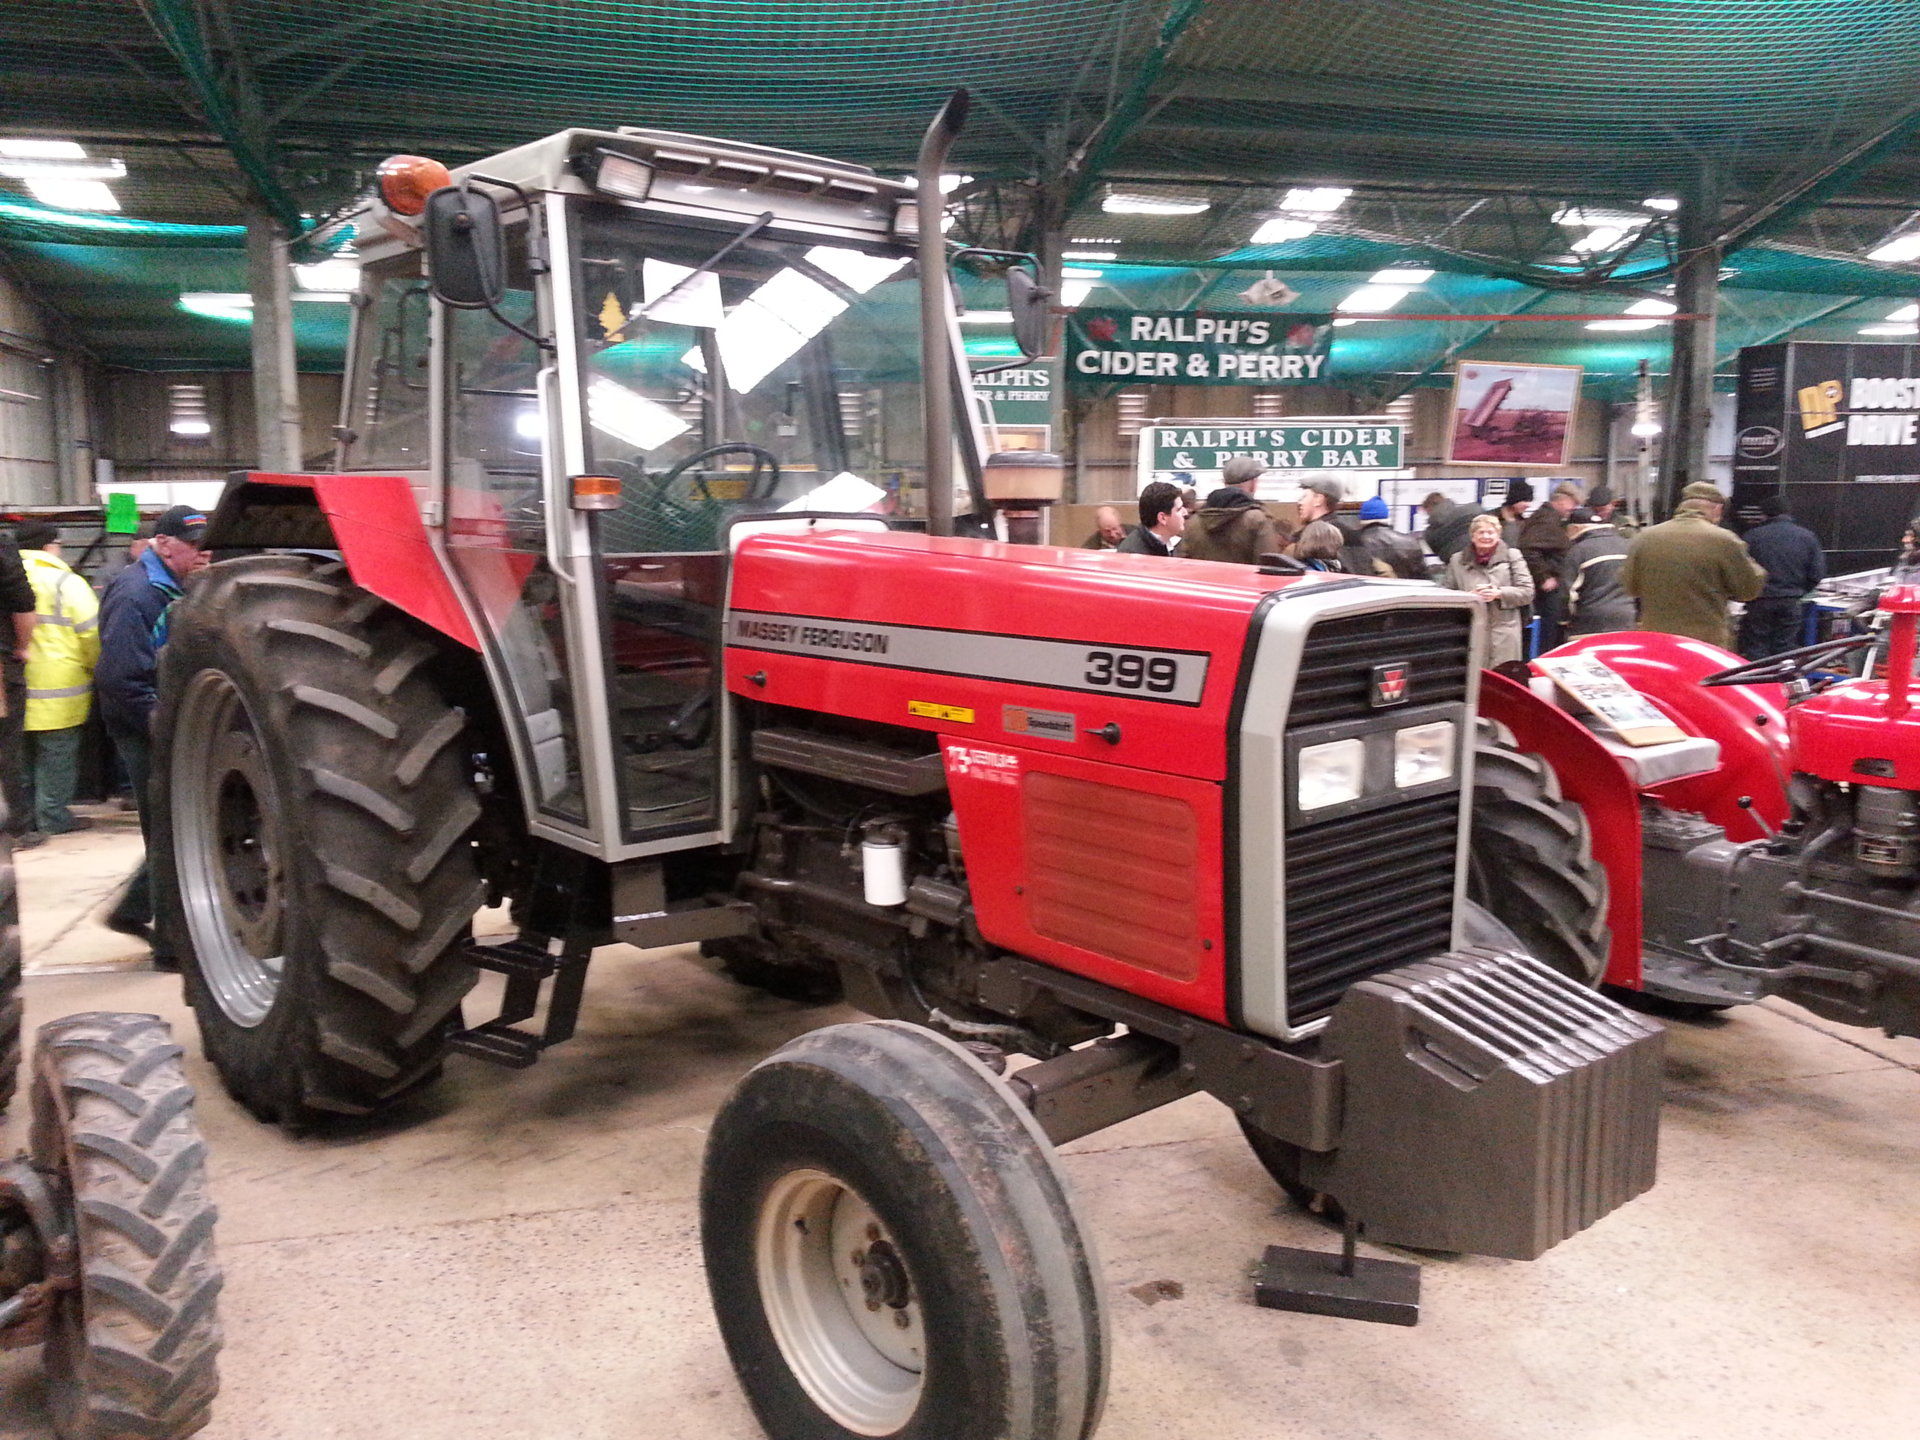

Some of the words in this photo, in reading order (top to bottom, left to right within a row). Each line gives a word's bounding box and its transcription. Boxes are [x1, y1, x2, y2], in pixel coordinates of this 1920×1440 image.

[1131, 316, 1271, 345] RALPH'S
[971, 369, 1050, 387] ALPH'S
[1075, 350, 1179, 377] CIDER
[1186, 353, 1210, 377] &
[1217, 354, 1325, 379] PERRY
[1160, 429, 1286, 448] RALPH'S
[1300, 428, 1394, 446] CIDER
[1172, 451, 1197, 469] &
[1321, 449, 1380, 466] BAR
[737, 619, 798, 643] MASSEY
[801, 626, 889, 654] FERGUSON
[1084, 651, 1177, 693] 399
